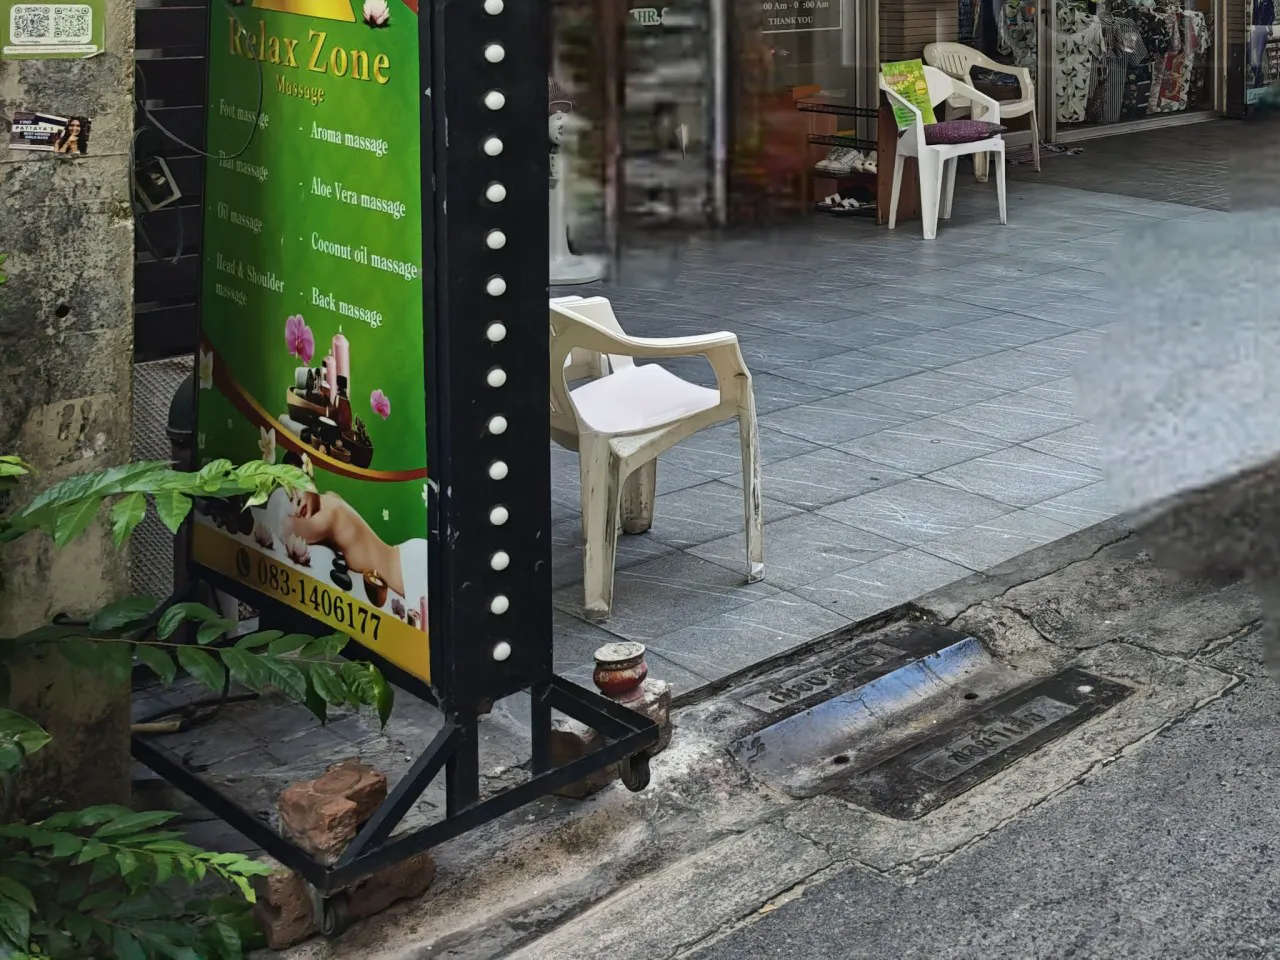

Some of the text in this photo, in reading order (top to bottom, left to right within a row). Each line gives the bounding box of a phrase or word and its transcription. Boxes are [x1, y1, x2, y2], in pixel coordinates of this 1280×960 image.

[632, 9, 660, 25] HR.
[768, 16, 814, 26] THANK YOU
[816, 1, 829, 9] Am
[228, 16, 391, 84] Relax Zone
[220, 98, 236, 117] Foot
[276, 74, 326, 107] Massage
[310, 120, 389, 158] Aroma massage
[219, 149, 269, 184] Thai massage
[310, 176, 407, 220] Aloe Vera massage
[217, 201, 264, 235] Oil massage
[216, 252, 286, 294] Head & Shoulder
[311, 231, 418, 282] Coconut oil massage
[215, 282, 249, 307] massage
[311, 286, 384, 329] Back massage
[257, 554, 383, 642] 083-1406177
